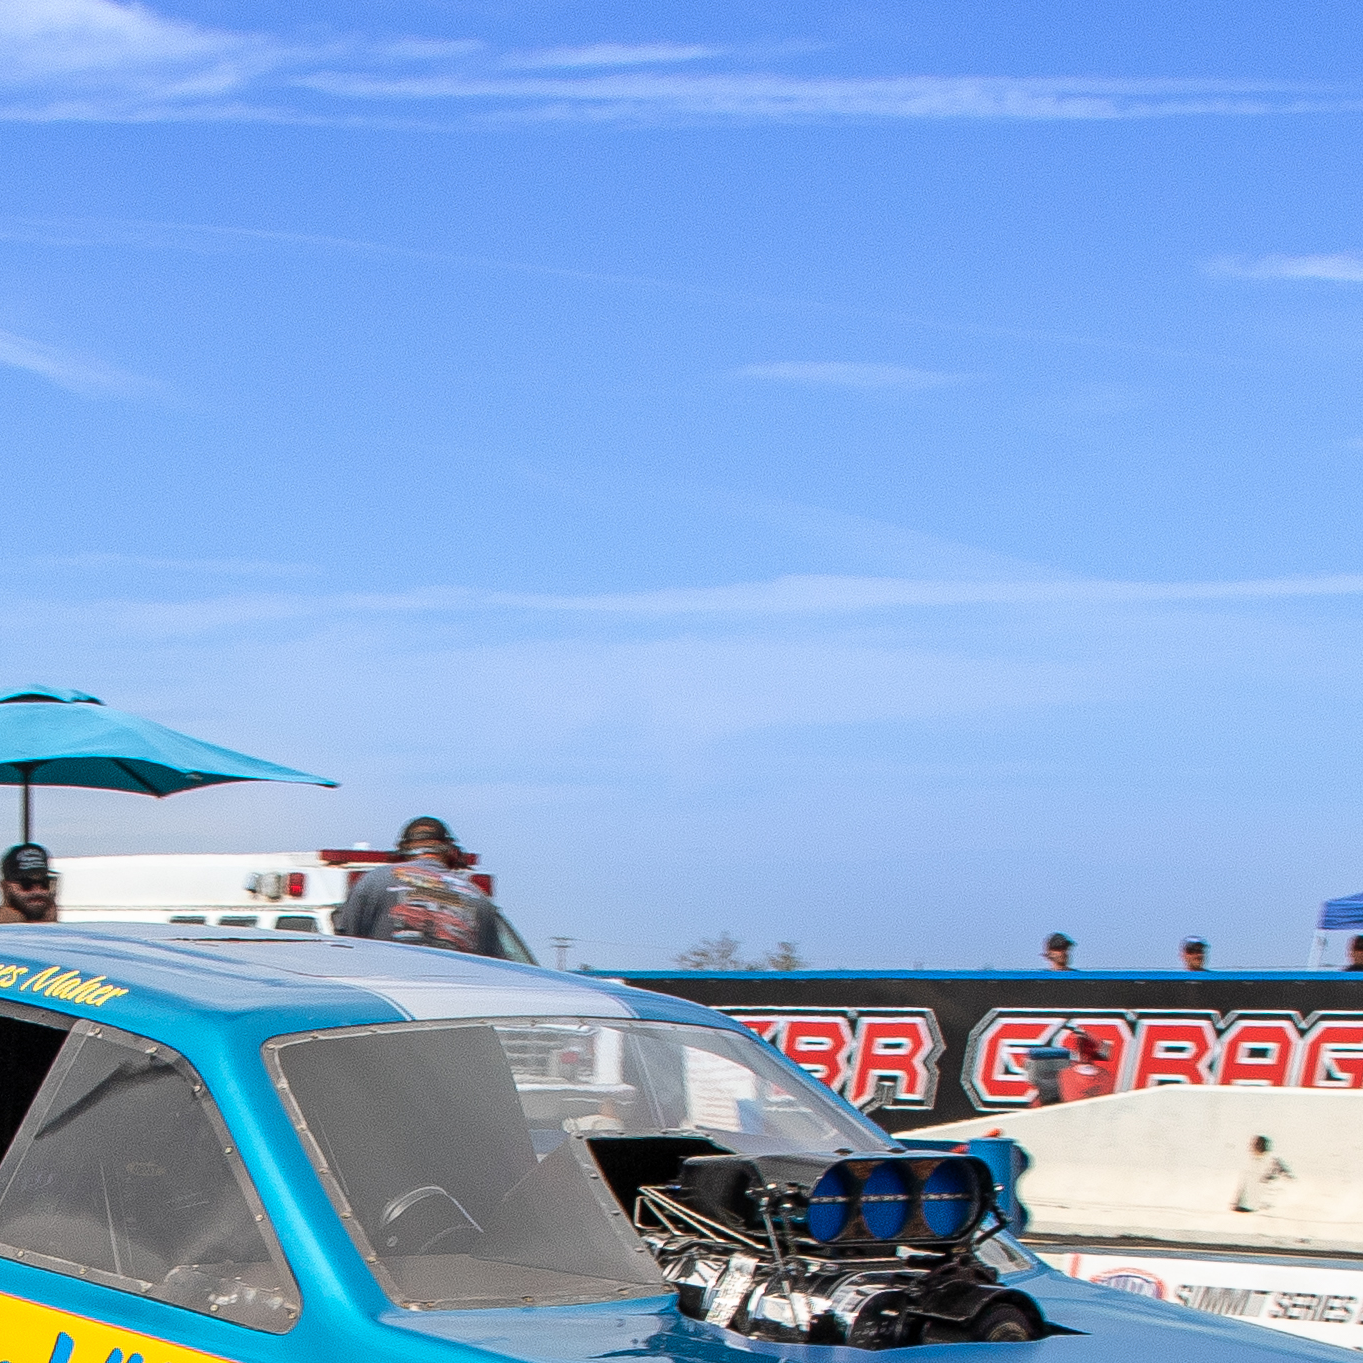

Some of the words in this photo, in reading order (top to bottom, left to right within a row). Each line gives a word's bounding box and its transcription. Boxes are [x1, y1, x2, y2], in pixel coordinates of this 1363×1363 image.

[20, 966, 129, 1006] Maher
[735, 1013, 939, 1110] BR
[1269, 1291, 1356, 1324] SERIES
